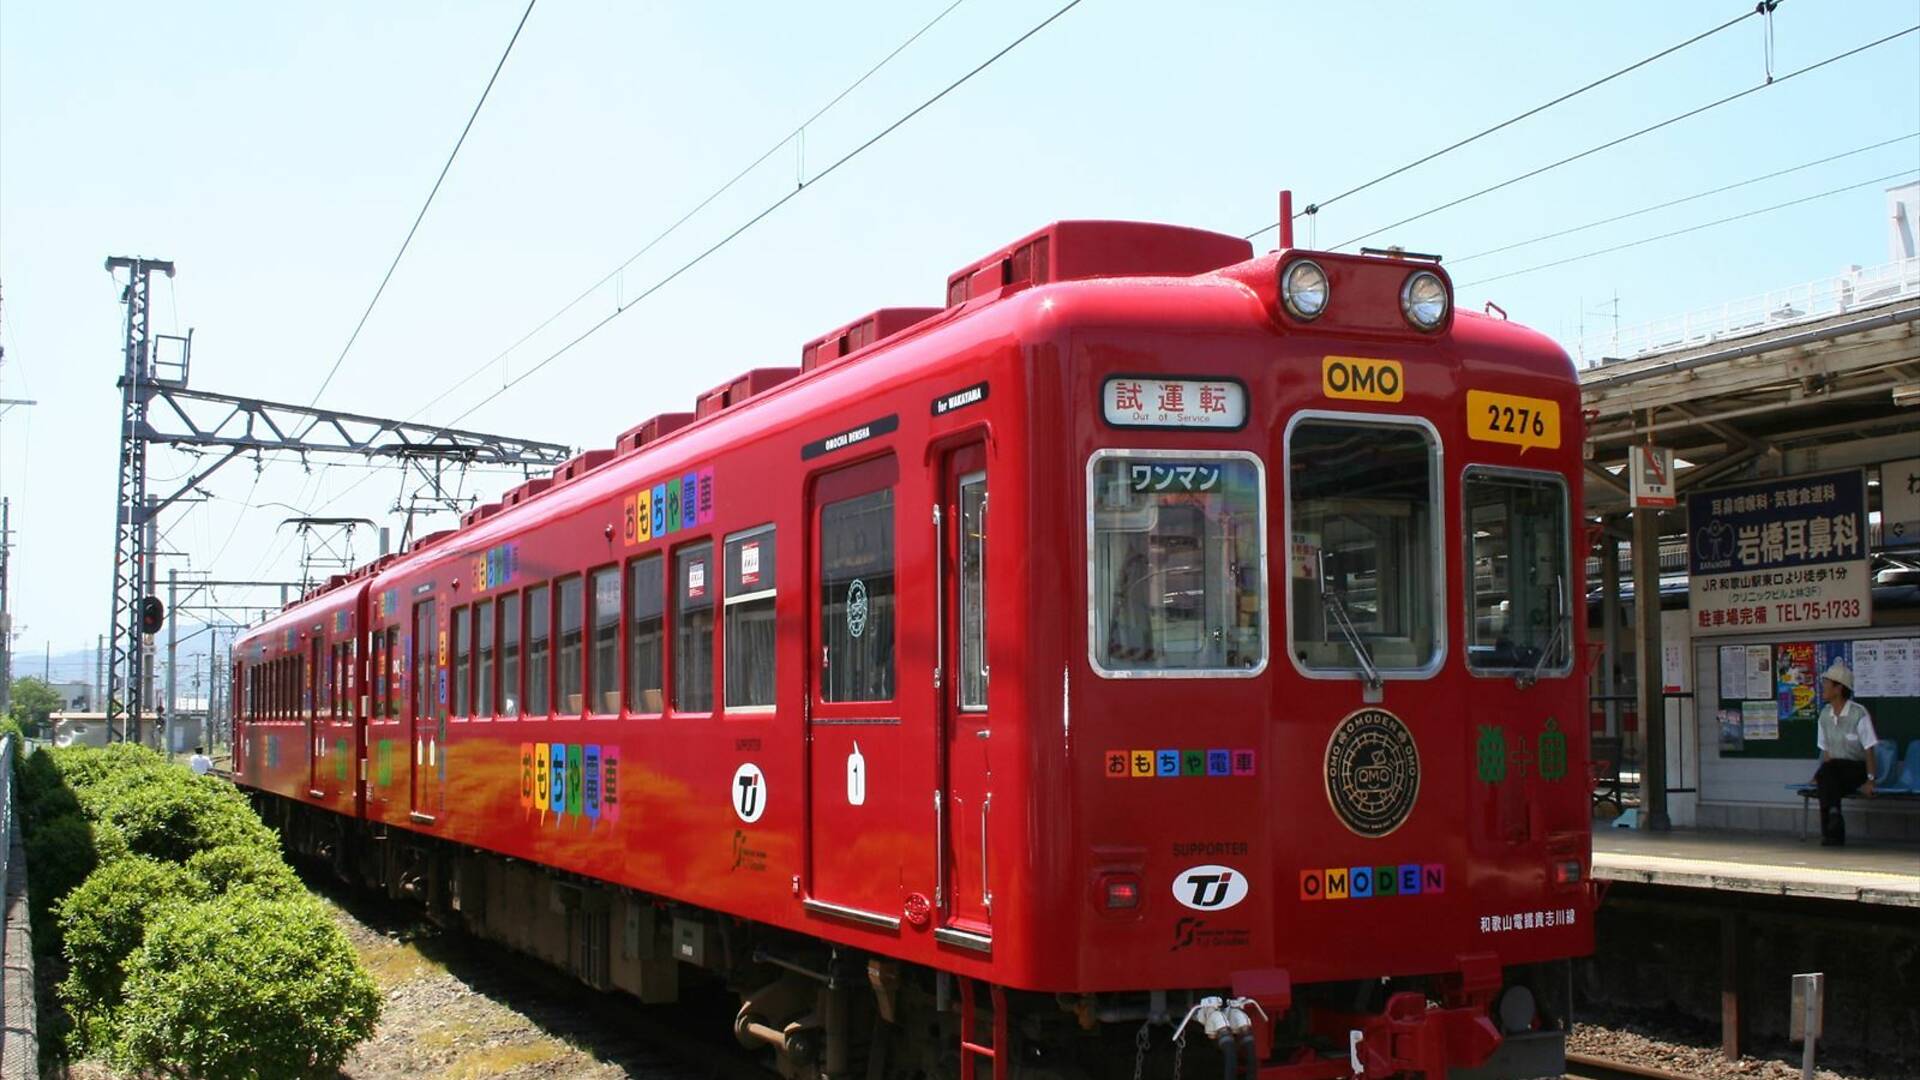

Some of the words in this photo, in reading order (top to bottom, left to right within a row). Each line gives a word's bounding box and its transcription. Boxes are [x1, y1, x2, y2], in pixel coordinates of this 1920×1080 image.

[1327, 362, 1399, 396] OMO
[1115, 382, 1227, 414] 試運転
[1132, 411, 1149, 421] Out
[1158, 412, 1168, 422] of
[1177, 413, 1210, 422] Service
[1488, 405, 1545, 437] 2276
[1132, 465, 1219, 491] ワンマン
[1737, 512, 1859, 565] 岩橋耳鼻科
[1346, 713, 1398, 733] OMODEN
[1359, 769, 1391, 782] OMO
[1303, 869, 1443, 896] OMODEN
